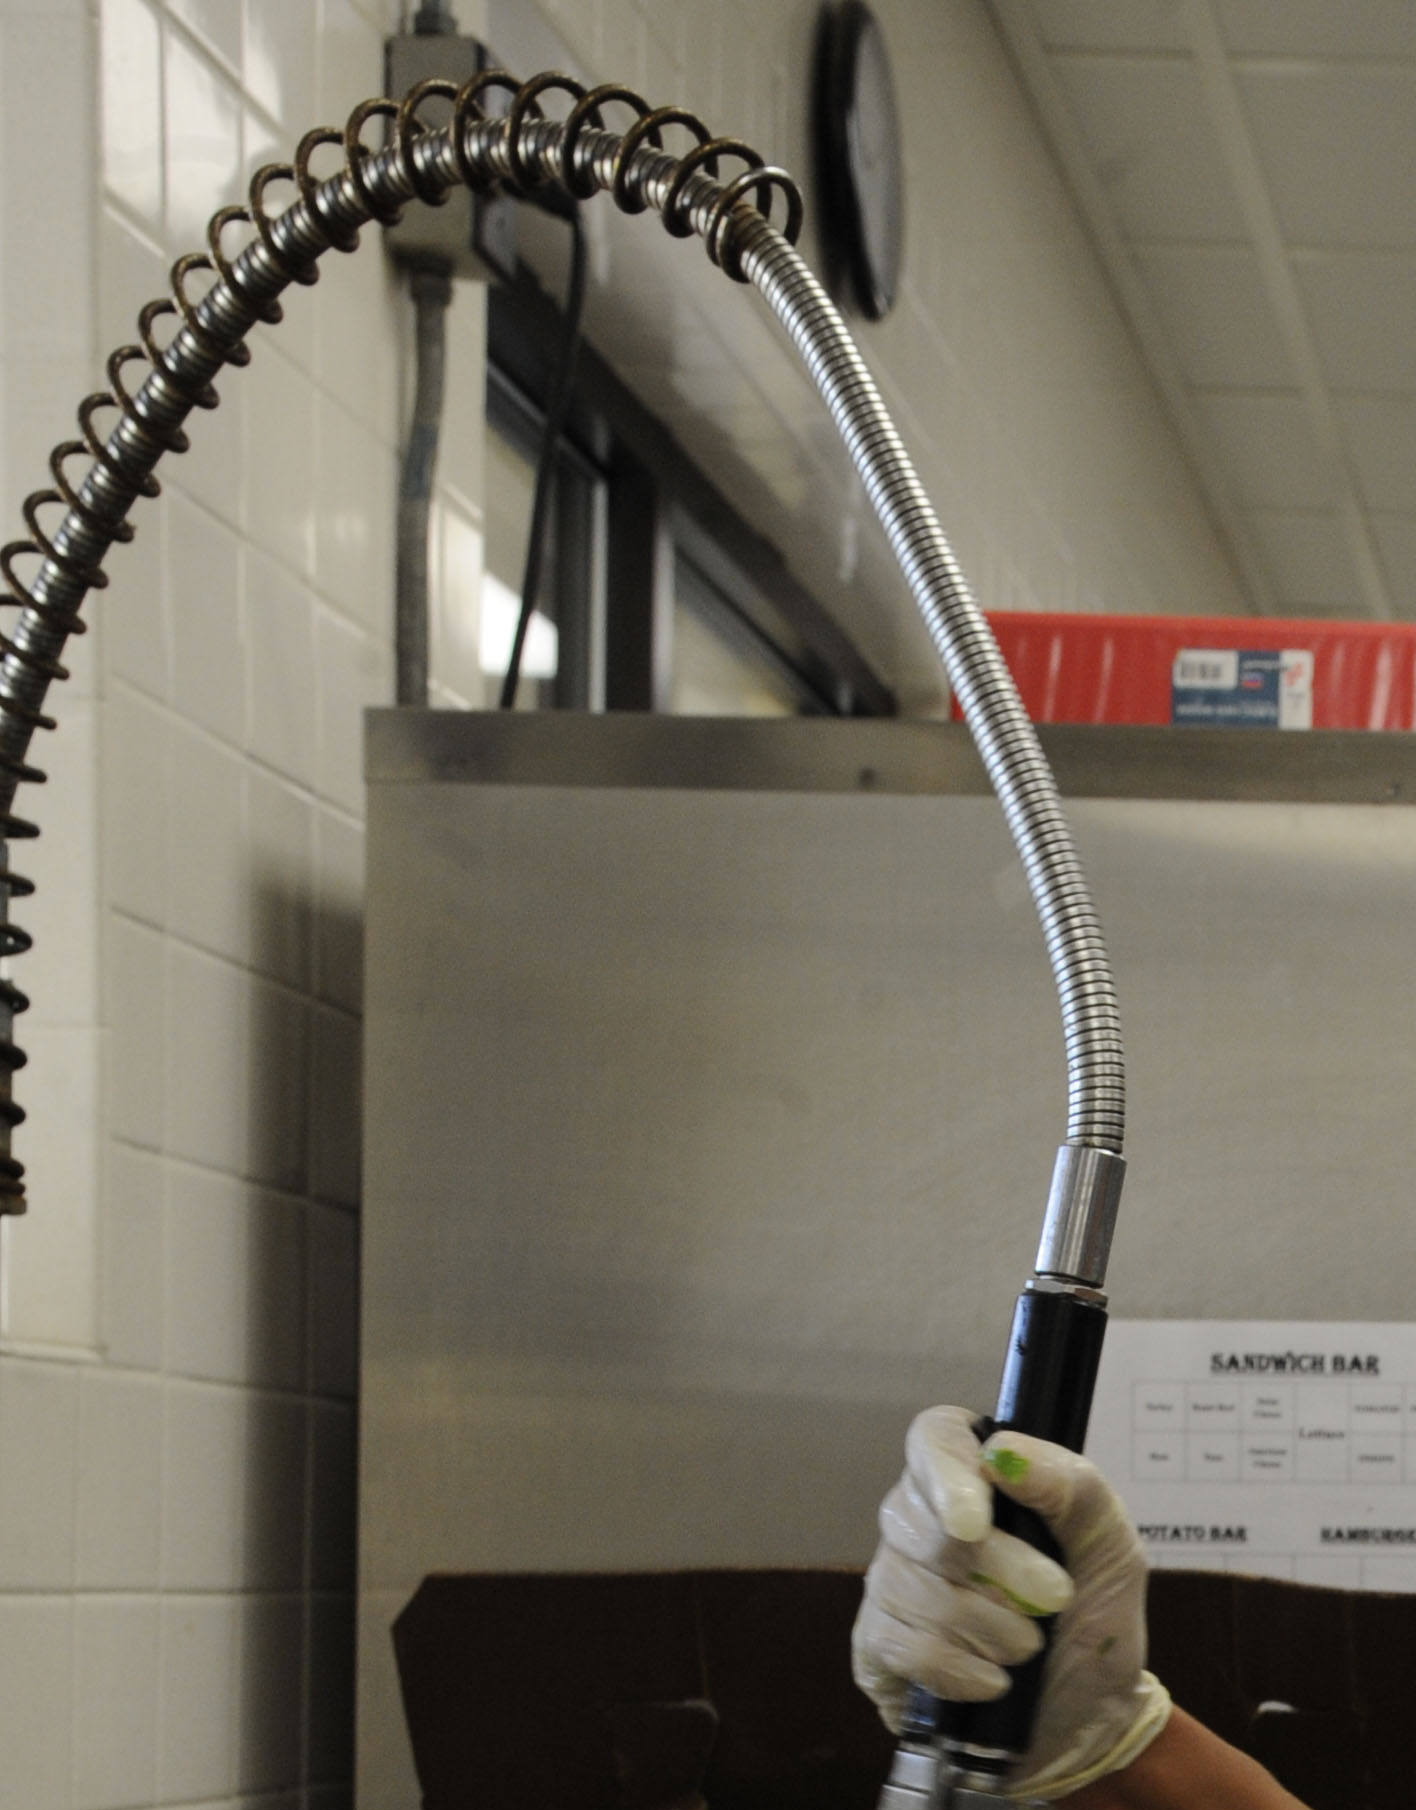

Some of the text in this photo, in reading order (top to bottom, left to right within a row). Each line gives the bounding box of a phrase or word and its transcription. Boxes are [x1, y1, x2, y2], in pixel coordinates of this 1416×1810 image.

[1210, 1352, 1380, 1376] SANDWICH BAR
[1210, 1525, 1247, 1543] BAR
